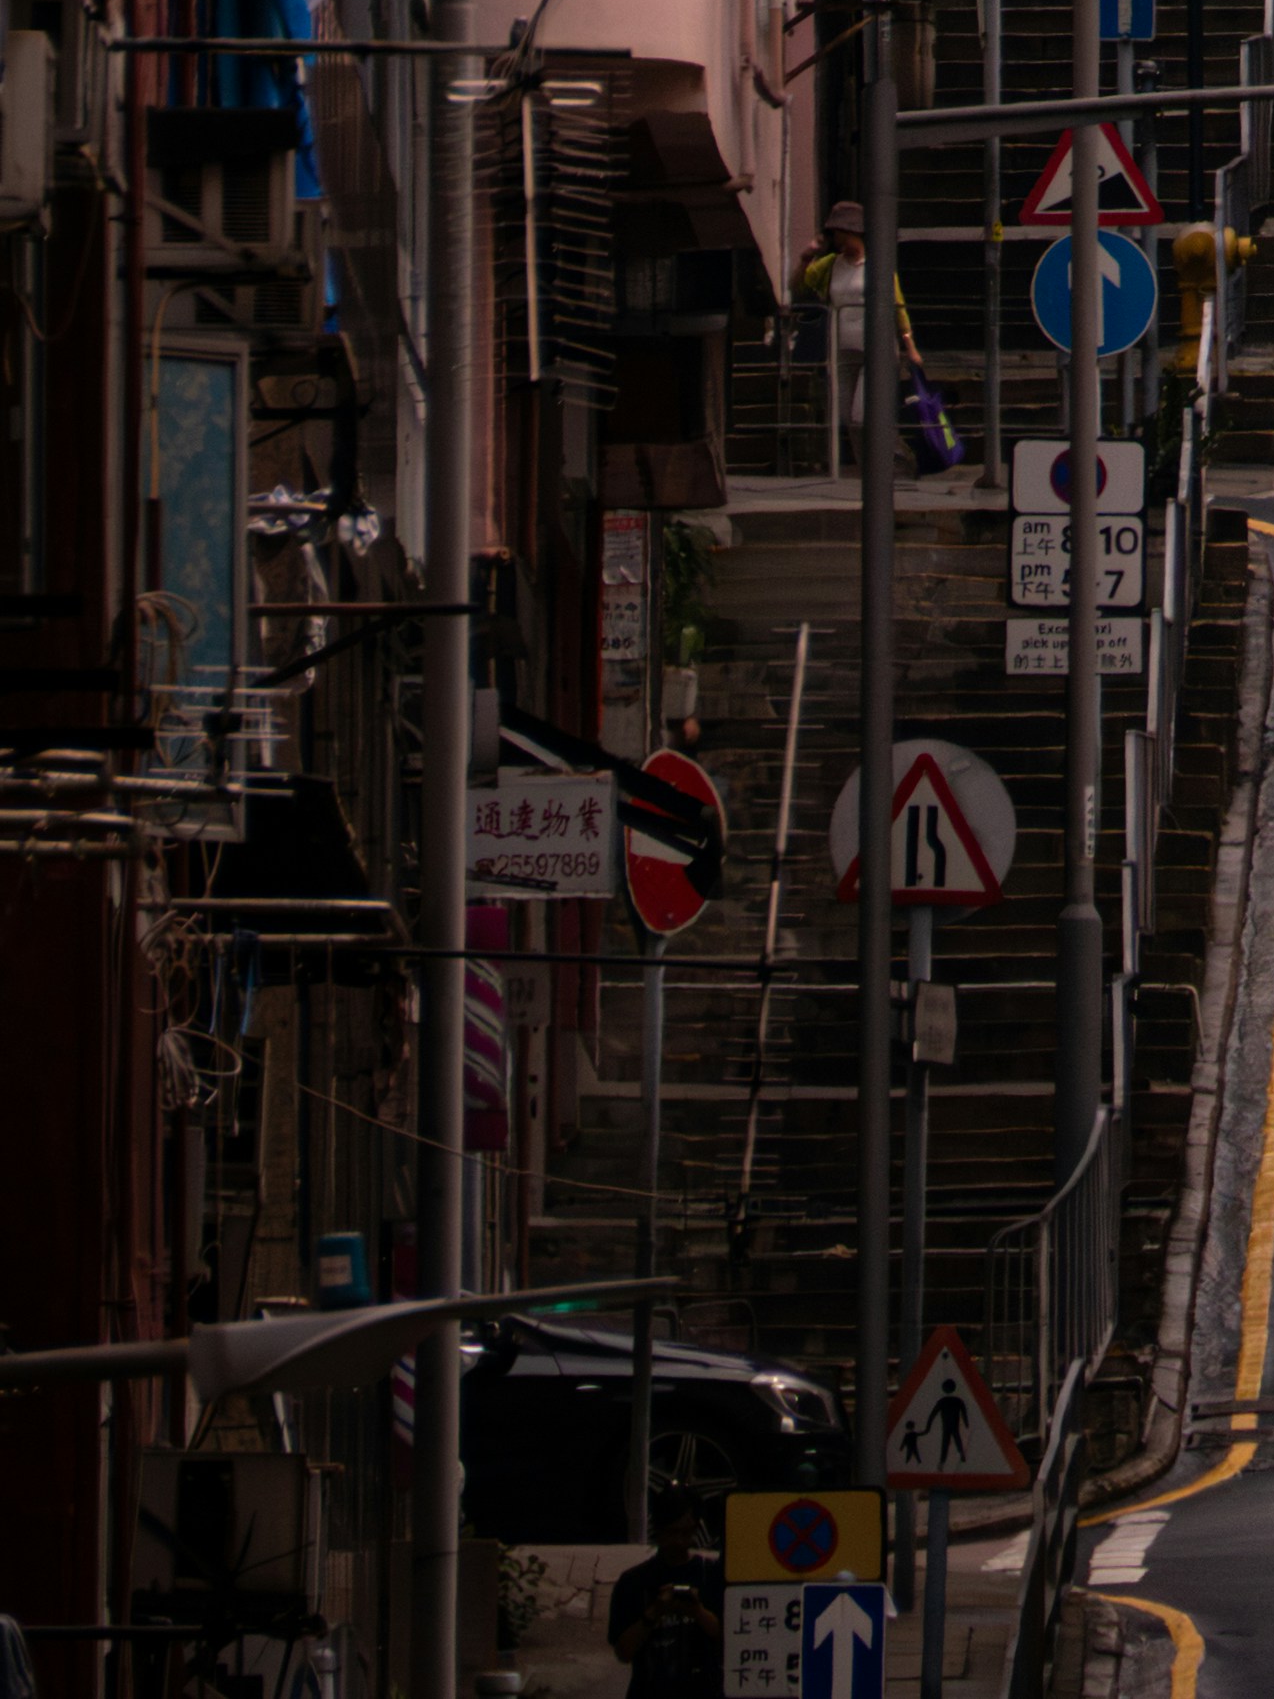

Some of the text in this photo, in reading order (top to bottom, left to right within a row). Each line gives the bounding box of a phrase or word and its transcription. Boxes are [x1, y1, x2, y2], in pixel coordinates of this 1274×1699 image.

[1023, 521, 1051, 534] am
[1016, 538, 1055, 556] 上午
[1021, 564, 1052, 581] pm
[1016, 581, 1055, 600] 下午
[474, 797, 603, 842] 通達物業
[497, 853, 601, 877] 25597869
[740, 1596, 769, 1610] am
[733, 1614, 777, 1635] 上午
[740, 1648, 769, 1666] pm
[732, 1667, 777, 1689] 下午
